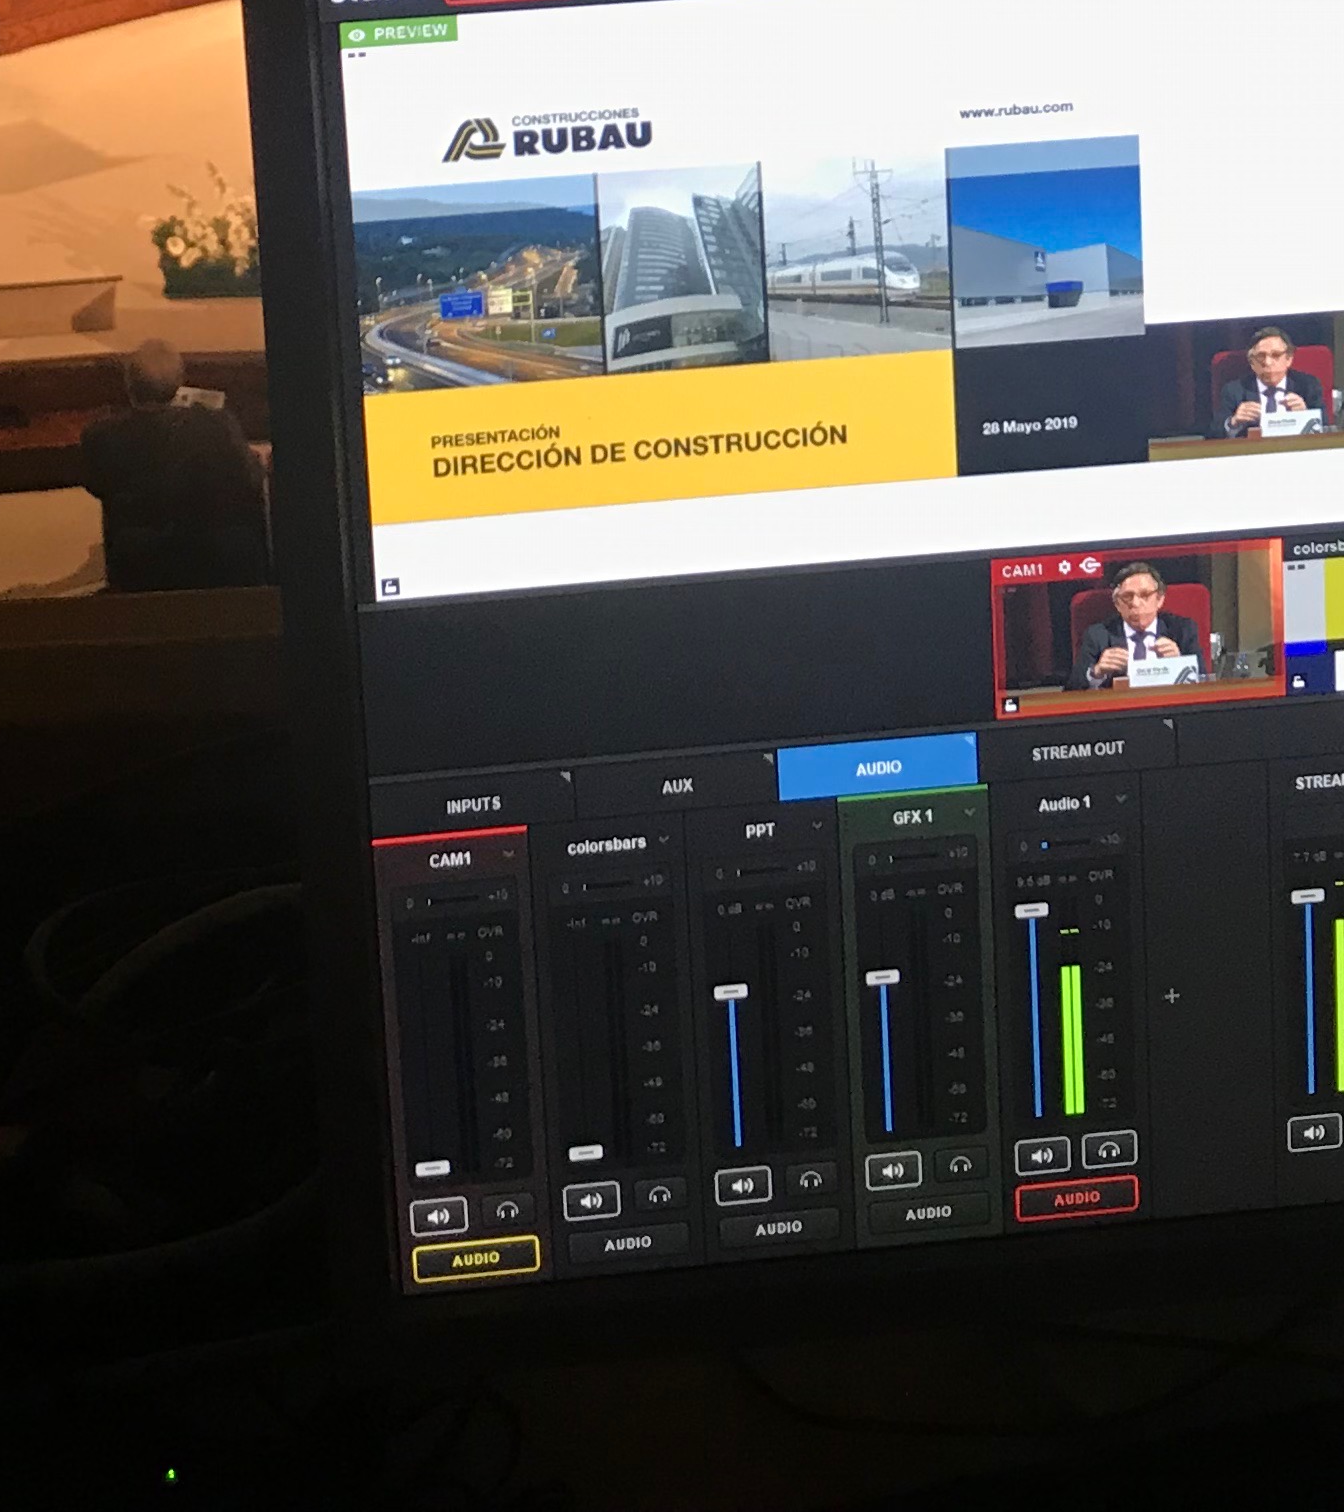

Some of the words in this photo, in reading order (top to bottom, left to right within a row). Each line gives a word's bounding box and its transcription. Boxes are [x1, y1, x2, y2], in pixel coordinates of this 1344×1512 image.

[374, 23, 448, 41] PREVIEW
[511, 106, 640, 129] CONSTRUCCIONES
[959, 102, 1074, 119] www.rubau.com
[512, 120, 653, 158] RUBAU
[982, 420, 1001, 437] 28
[1002, 419, 1042, 436] Mayo
[1044, 414, 1078, 431] 2019
[431, 424, 560, 449] PRESENTACIÓN
[433, 441, 582, 479] DIRECCIÓN
[590, 442, 626, 464] DE
[633, 420, 849, 461] CONSTRUCCIÓN
[1001, 562, 1044, 580] CAM1
[1032, 744, 1092, 764] STREAM
[1095, 739, 1126, 757] OUT
[856, 759, 903, 777] AUDIO
[662, 777, 694, 796] AUX
[446, 795, 502, 816] INPUTS
[1038, 796, 1079, 813] Audio
[1082, 795, 1092, 809] 1
[893, 810, 922, 826] GFX
[924, 808, 934, 823] 1
[745, 821, 776, 839] PPT
[567, 835, 647, 856] colorsbars
[429, 850, 472, 869] CAM1
[477, 924, 505, 940] OVR
[1054, 1188, 1102, 1208] AUDIO
[905, 1204, 952, 1223] AUDIO
[755, 1219, 803, 1239] AUDIO
[604, 1234, 652, 1254] AUDIO
[452, 1249, 501, 1270] AUDIO
